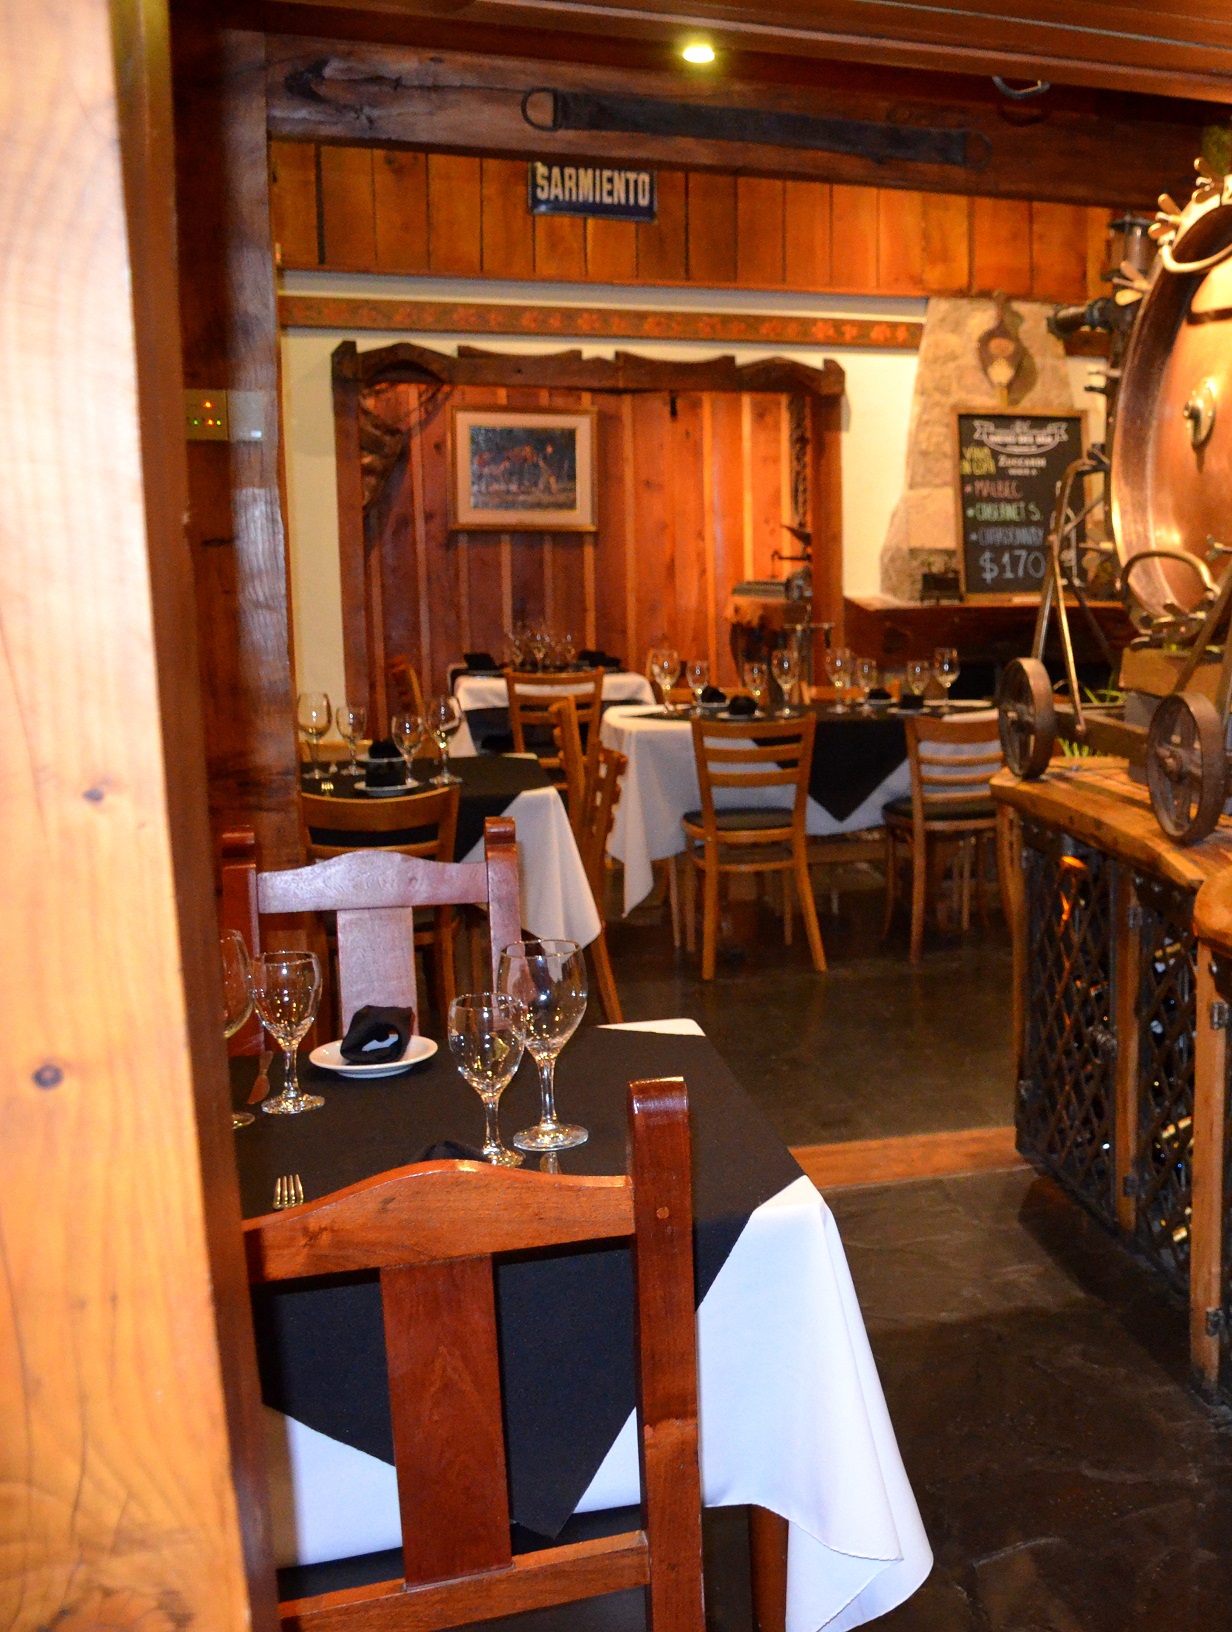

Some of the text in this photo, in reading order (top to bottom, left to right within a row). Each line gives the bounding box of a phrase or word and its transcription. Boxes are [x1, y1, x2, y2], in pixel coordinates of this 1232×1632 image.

[535, 161, 650, 208] SARMIENTO
[974, 480, 1024, 500] MALBEC
[975, 502, 1026, 522] CABERNET
[979, 549, 1046, 584] $170
